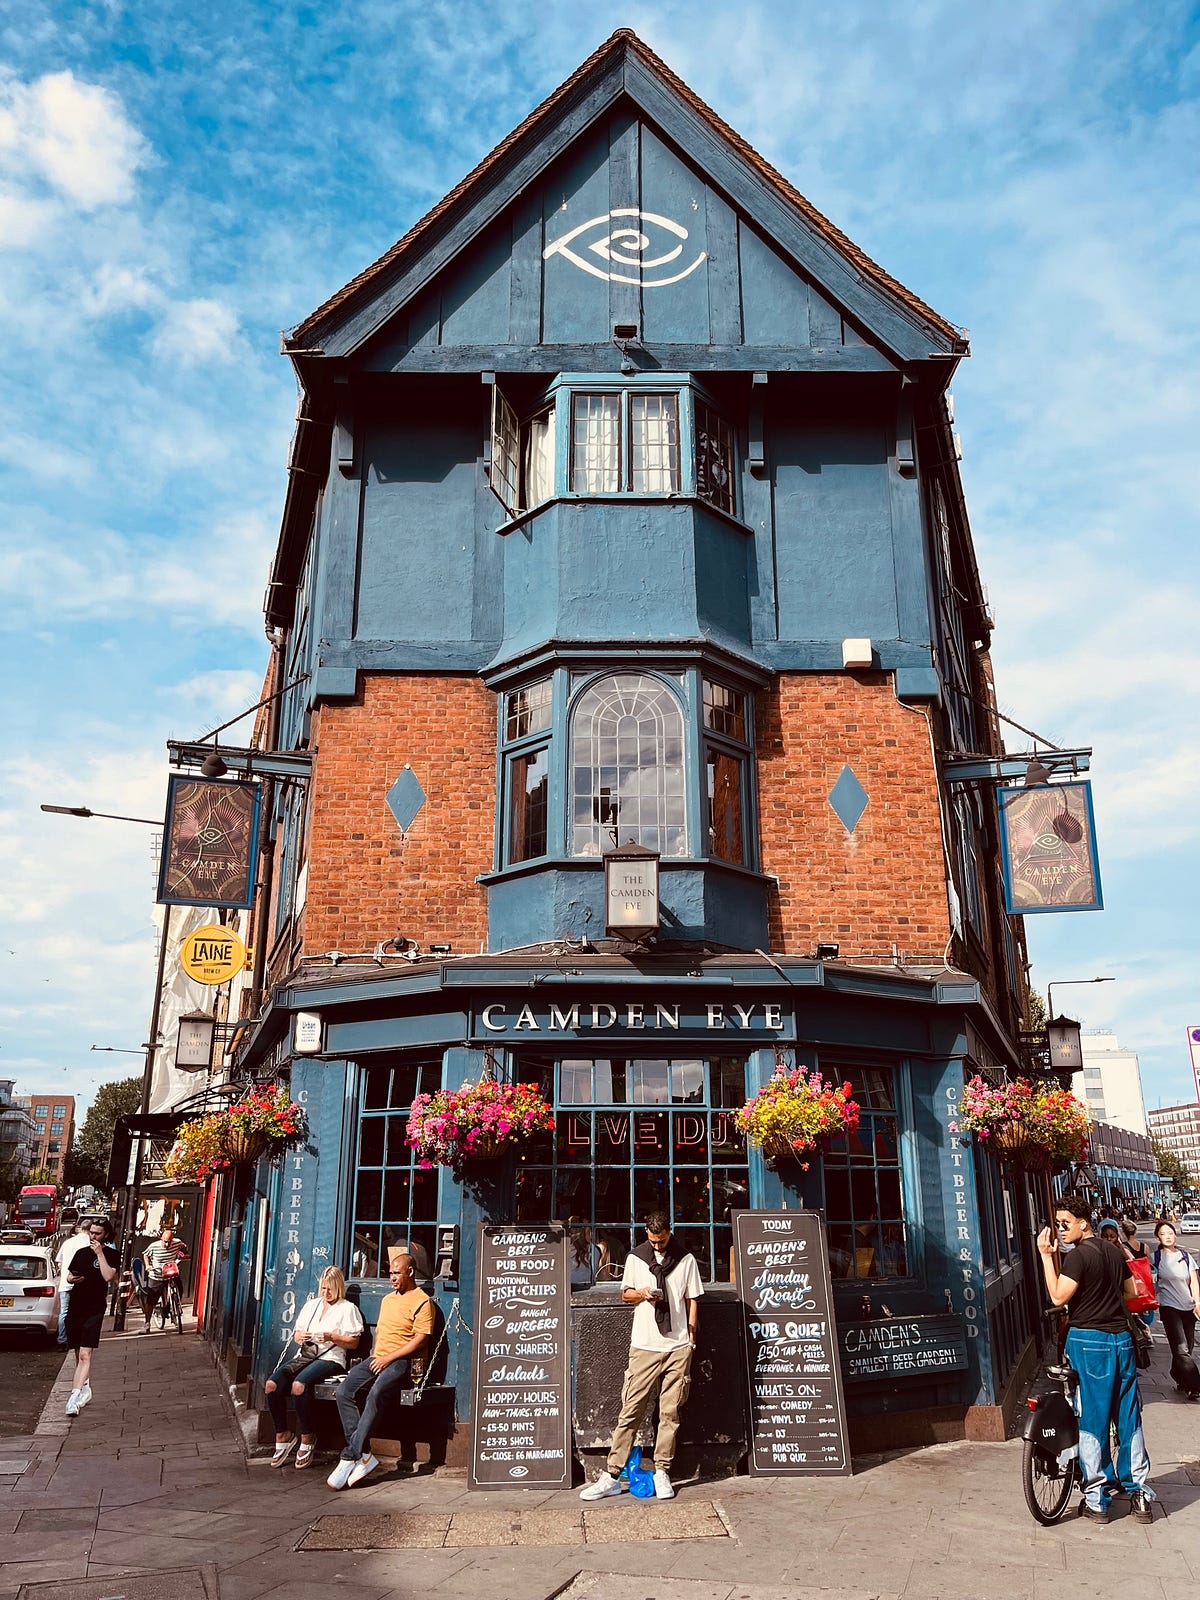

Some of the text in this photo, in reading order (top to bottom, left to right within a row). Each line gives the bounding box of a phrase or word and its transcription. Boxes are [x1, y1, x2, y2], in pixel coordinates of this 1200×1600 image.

[198, 871, 218, 880] EYE
[1025, 864, 1079, 876] CAMDEN
[623, 876, 643, 884] THE
[1042, 876, 1063, 885] EYE
[610, 889, 655, 897] CAMDEN
[625, 902, 642, 910] EYE
[191, 942, 233, 962] LAINE
[481, 1003, 785, 1031] CAMDEN EYE
[677, 1112, 727, 1146] DJ
[952, 1174, 970, 1240] BEER
[761, 1220, 792, 1230] TODAY
[507, 1245, 536, 1256] BEST
[747, 1240, 807, 1255] CAMDEN'S
[764, 1254, 795, 1266] BEST
[959, 1247, 972, 1262] &
[496, 1259, 555, 1270] PUB FOOD!
[486, 1276, 530, 1285] TRADITIONAL
[751, 1269, 812, 1290] Sunday
[489, 1286, 517, 1304] FISH
[521, 1284, 557, 1296] CHIPS
[755, 1287, 804, 1310] Roast
[962, 1269, 979, 1338] FOOD
[506, 1318, 559, 1334] BURGERS
[749, 1321, 826, 1338] PUB QUIZ!
[845, 1323, 921, 1352] CAMDEN'S
[484, 1343, 558, 1355] TASTY SHARERS!
[757, 1344, 780, 1362] £50
[781, 1345, 797, 1356] TAB
[803, 1351, 825, 1359] PRIZES
[892, 1352, 916, 1370] BEER
[488, 1364, 549, 1382] Salads
[755, 1362, 831, 1373] EVERYONE'S A WINNER
[755, 1384, 794, 1396] WHAT'S
[487, 1391, 557, 1404] HOPPY HOURS
[781, 1401, 813, 1410] COMEDY
[771, 1415, 793, 1424] VINYL
[795, 1415, 807, 1423] DJ
[511, 1422, 535, 1431] PINTS
[775, 1429, 786, 1438] DJ
[510, 1436, 535, 1445] SHOTS
[772, 1443, 800, 1452] ROASTS
[525, 1449, 564, 1460] MARGARITAS
[773, 1453, 807, 1463] PUB QUIZ
